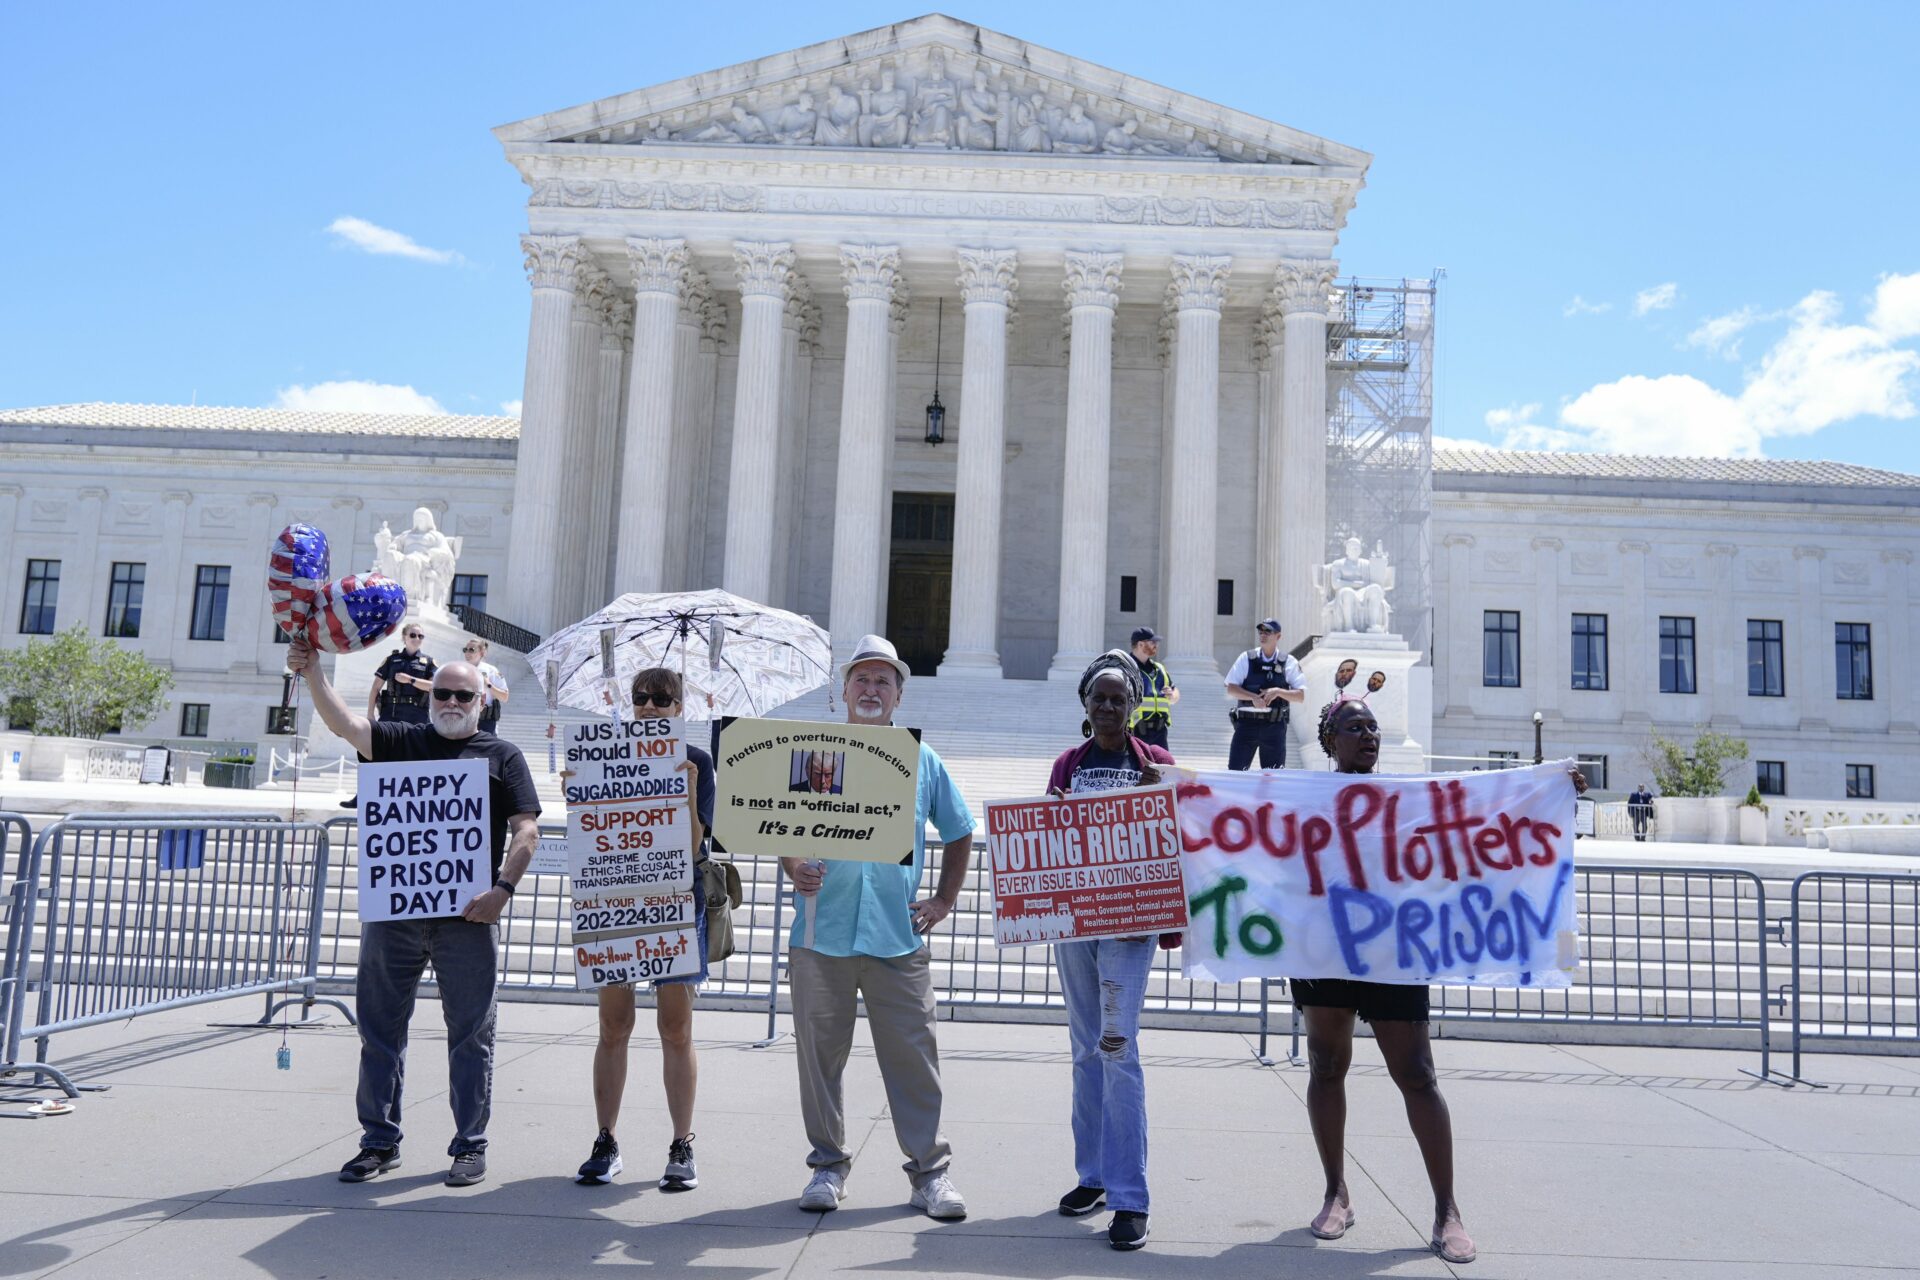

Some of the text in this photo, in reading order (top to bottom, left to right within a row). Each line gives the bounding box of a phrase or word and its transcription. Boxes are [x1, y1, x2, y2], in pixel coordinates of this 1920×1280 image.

[779, 194, 1081, 217] EQUAL JUSTICE UNDER LAW
[567, 742, 630, 762] should
[637, 738, 679, 757] NOT
[726, 733, 911, 778] Plotting to overturn an election
[603, 763, 650, 779] have
[1088, 769, 1141, 781] ANNIVERSA
[378, 773, 468, 797] HAPPY
[566, 777, 685, 804] SUGARDADDIES
[365, 797, 483, 826] BANNON
[731, 795, 900, 818] is not an “official act,”
[994, 795, 1169, 832] UNITE TO FIGHT FOR
[580, 807, 677, 832] SUPPORT
[758, 820, 874, 840] It’s a Crime!
[366, 827, 483, 858] GOES TO
[549, 843, 568, 852] CLO
[990, 818, 1178, 872] VOTING RIGHTS
[1335, 780, 1562, 892] Plotters
[581, 860, 687, 877] ETHICS, RECUSAL +
[588, 850, 684, 865] SUPREME COURT
[370, 859, 474, 888] PRISON
[573, 870, 685, 889] TRANSPARENCY ACT
[998, 875, 1035, 894] EVERY
[1039, 872, 1073, 891] ISSUE
[1075, 870, 1086, 888] IS
[1089, 869, 1097, 887] A
[1098, 865, 1141, 886] VOTING
[390, 889, 458, 915] DAY!
[574, 895, 693, 911] CALL YOUR SENATOR
[1071, 885, 1181, 904] Labor, Education, Environment
[1074, 898, 1184, 917] Women, Government, Criminal Justice
[1083, 912, 1174, 927] Healthcare and Immigration
[1328, 861, 1571, 976] PRISON
[577, 934, 688, 967] One-Hour Protest
[639, 957, 674, 978] 307
